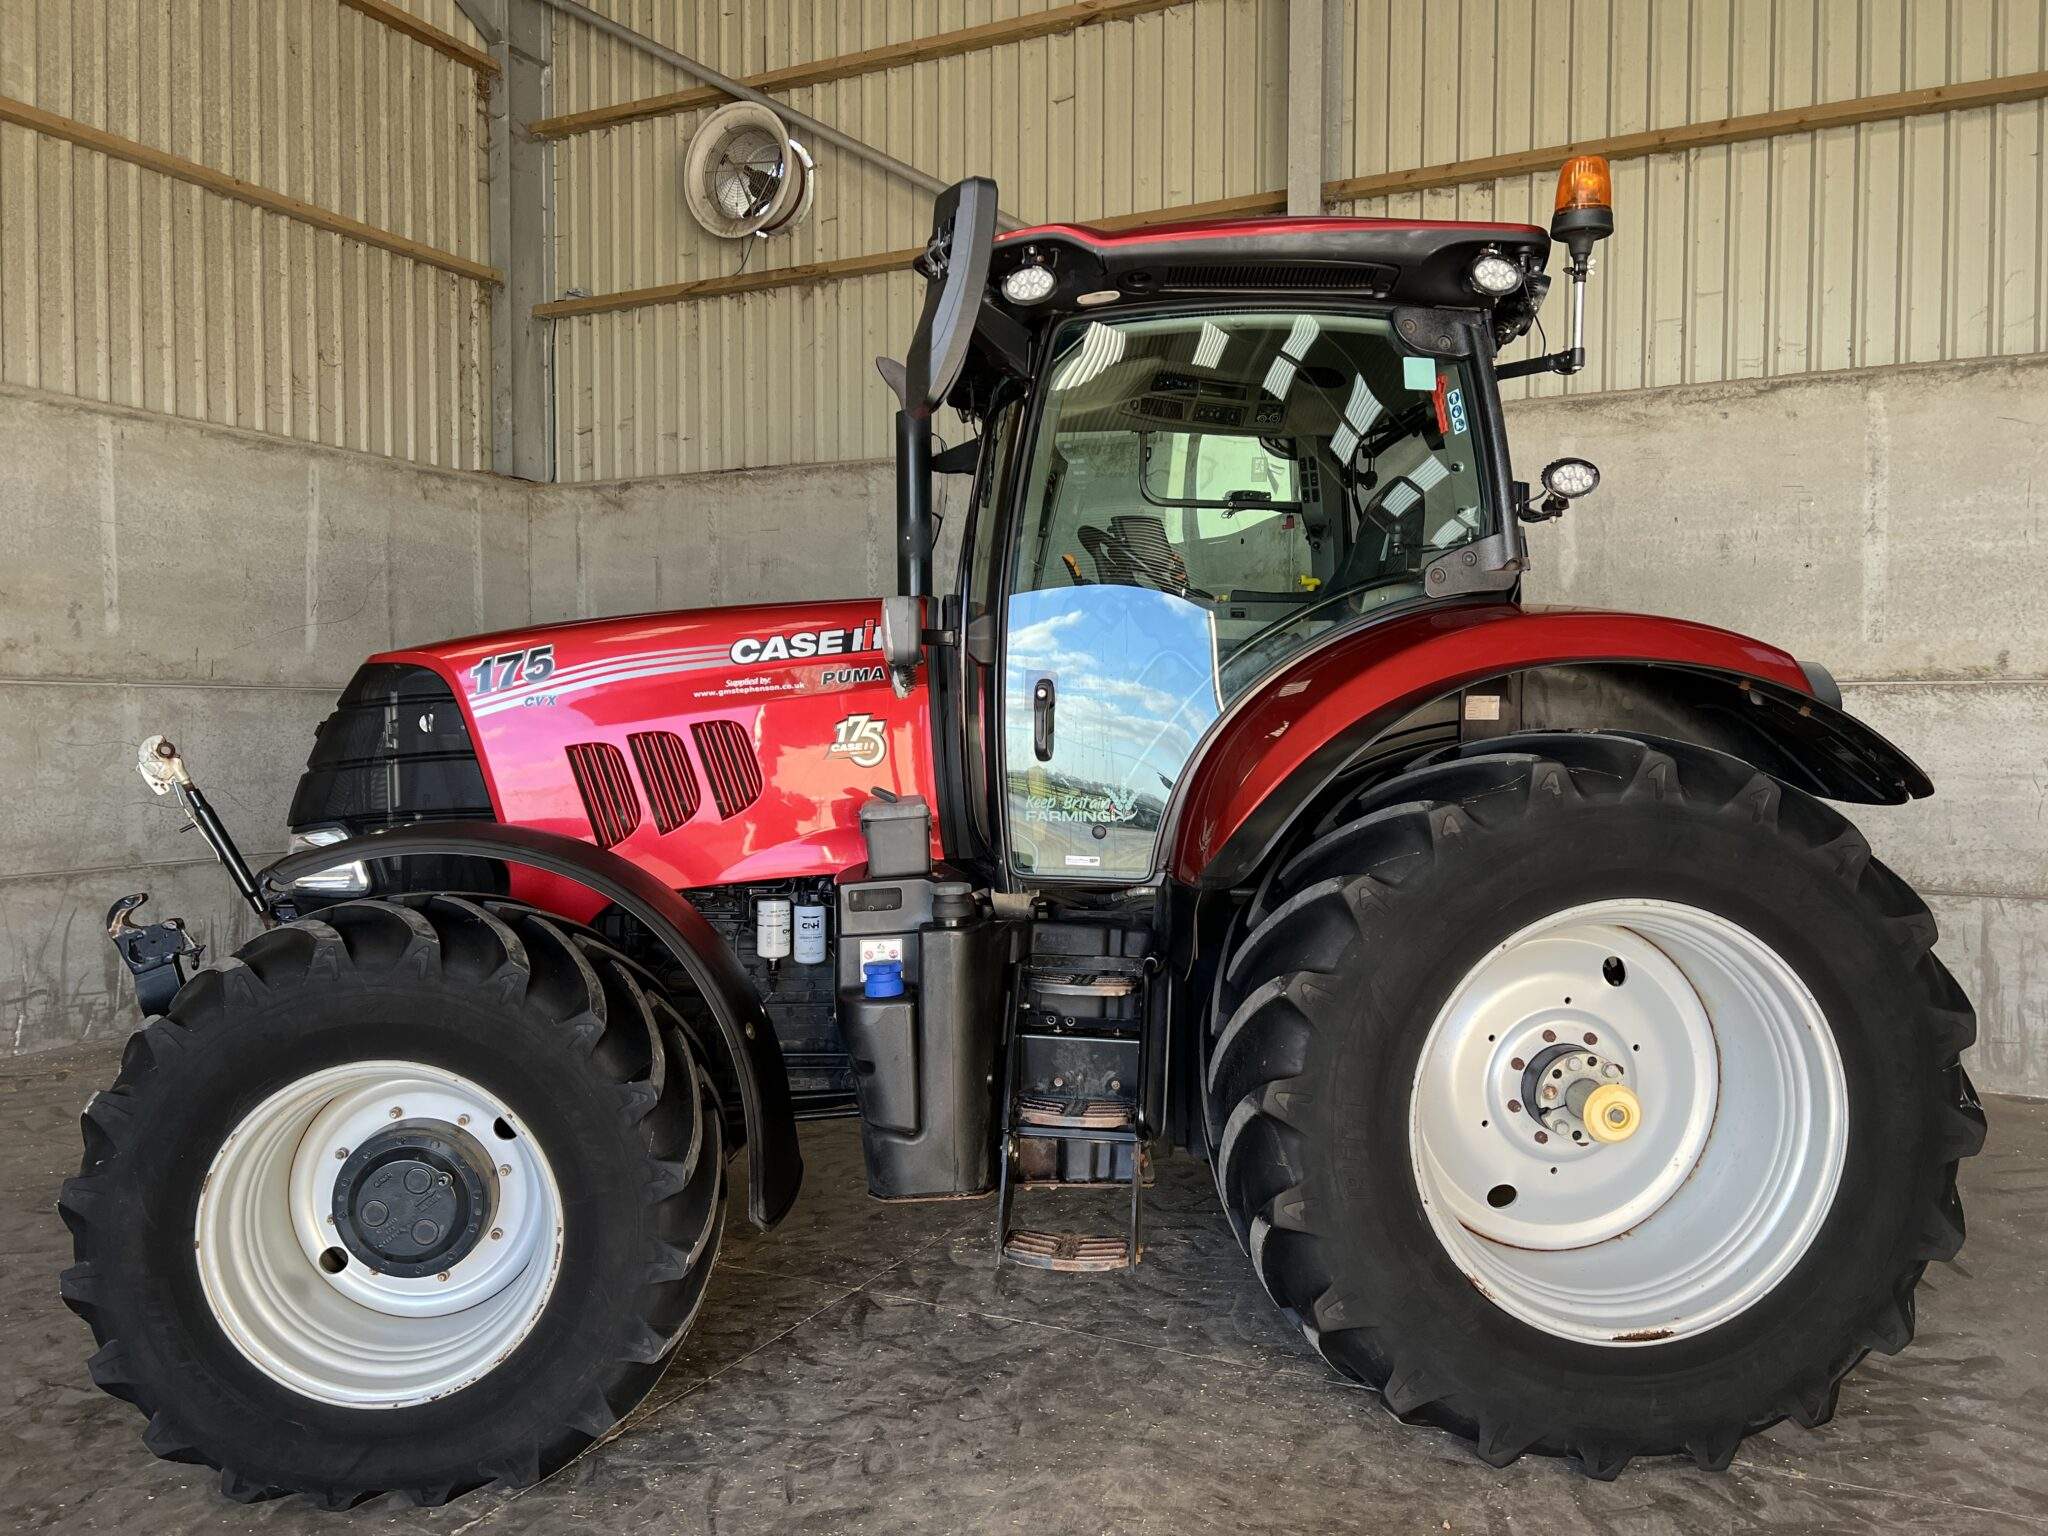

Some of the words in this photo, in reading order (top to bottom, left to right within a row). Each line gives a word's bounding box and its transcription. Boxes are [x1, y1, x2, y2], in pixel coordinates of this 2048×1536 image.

[730, 629, 844, 664] CASE
[470, 644, 555, 695] 175
[821, 667, 885, 685] PUMA
[692, 681, 805, 698] www.gmstephenson.co.uk
[725, 677, 759, 688] Supplied
[522, 695, 556, 707] CVX
[834, 711, 886, 767] 175
[1025, 795, 1056, 812] Keep
[1063, 794, 1111, 810] Britain
[1025, 810, 1112, 823] FARMING
